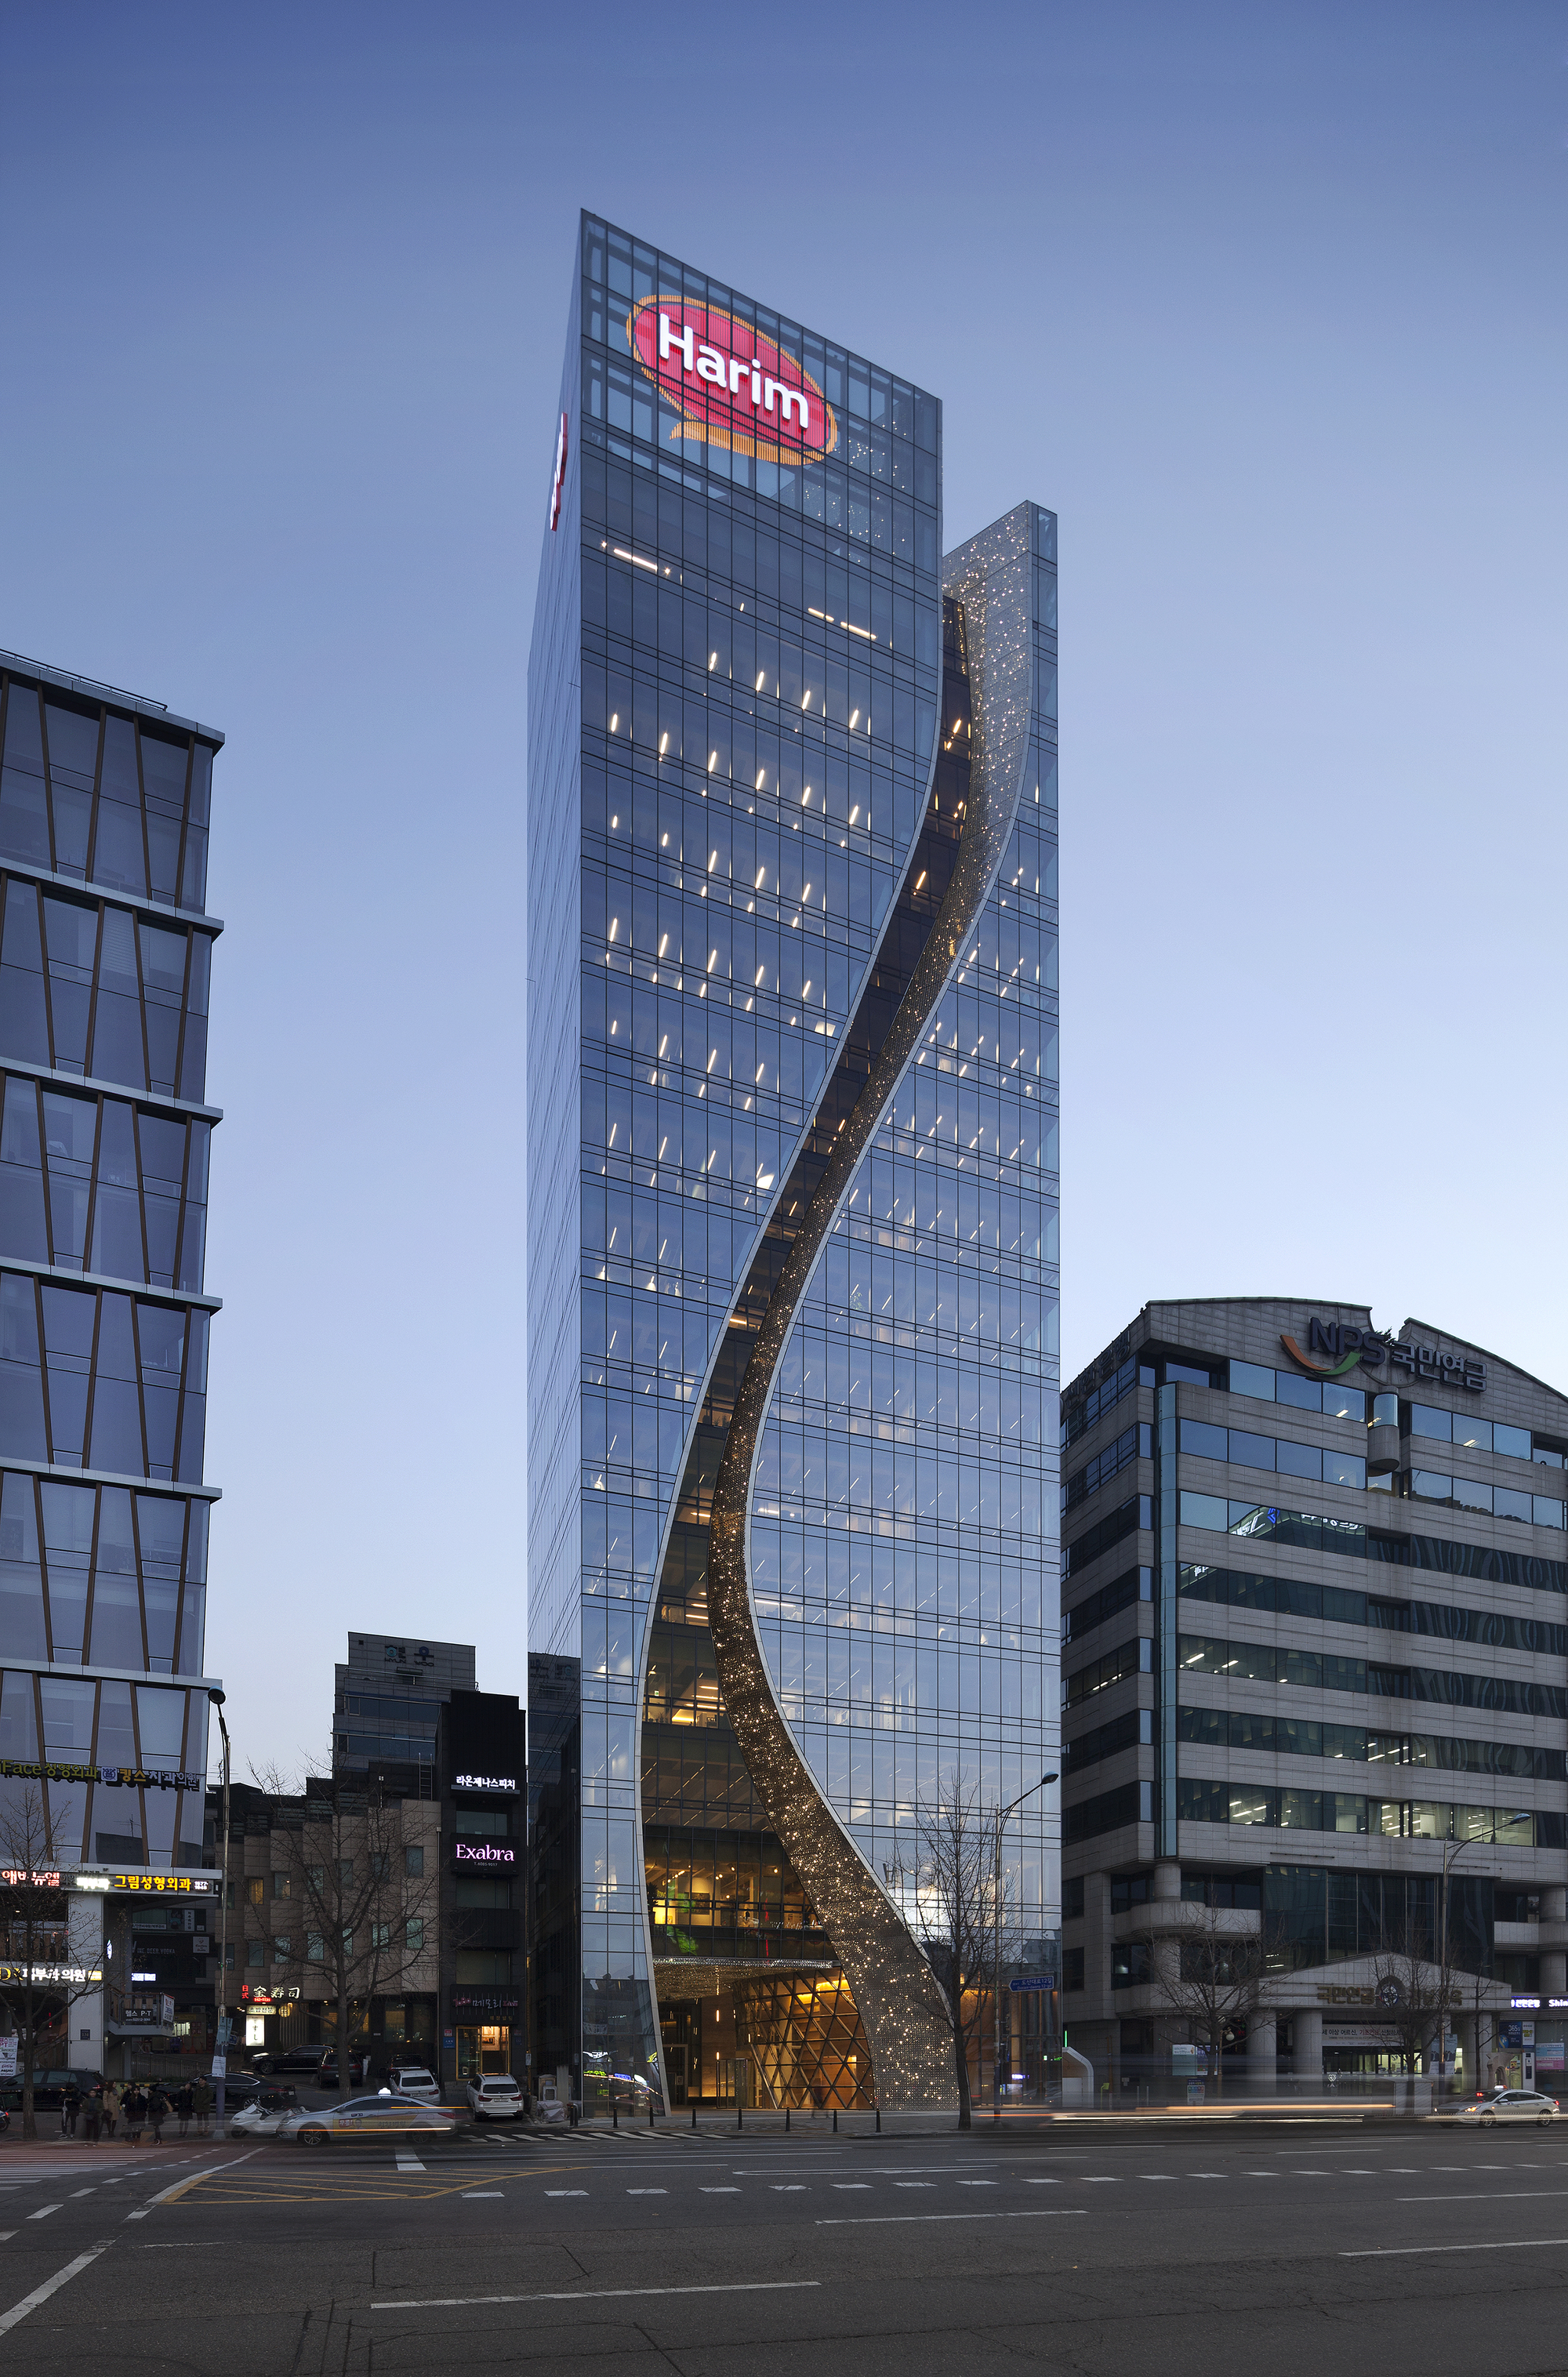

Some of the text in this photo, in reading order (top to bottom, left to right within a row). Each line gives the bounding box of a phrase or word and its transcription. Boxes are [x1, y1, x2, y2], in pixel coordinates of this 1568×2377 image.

[659, 313, 808, 429] Harim
[1310, 1317, 1487, 1392] NPS 국민연금
[1065, 1330, 1130, 1409] 신한은행
[0, 1759, 99, 1779] Face 성형외과
[456, 1844, 515, 1861] Exabra
[114, 1875, 191, 1892] 그림성형외과
[1021, 1977, 1052, 1986] 도산대로12길
[241, 1985, 249, 1999] 日式
[1317, 1986, 1375, 2005] 국민연금
[472, 1998, 502, 2009] 메모리
